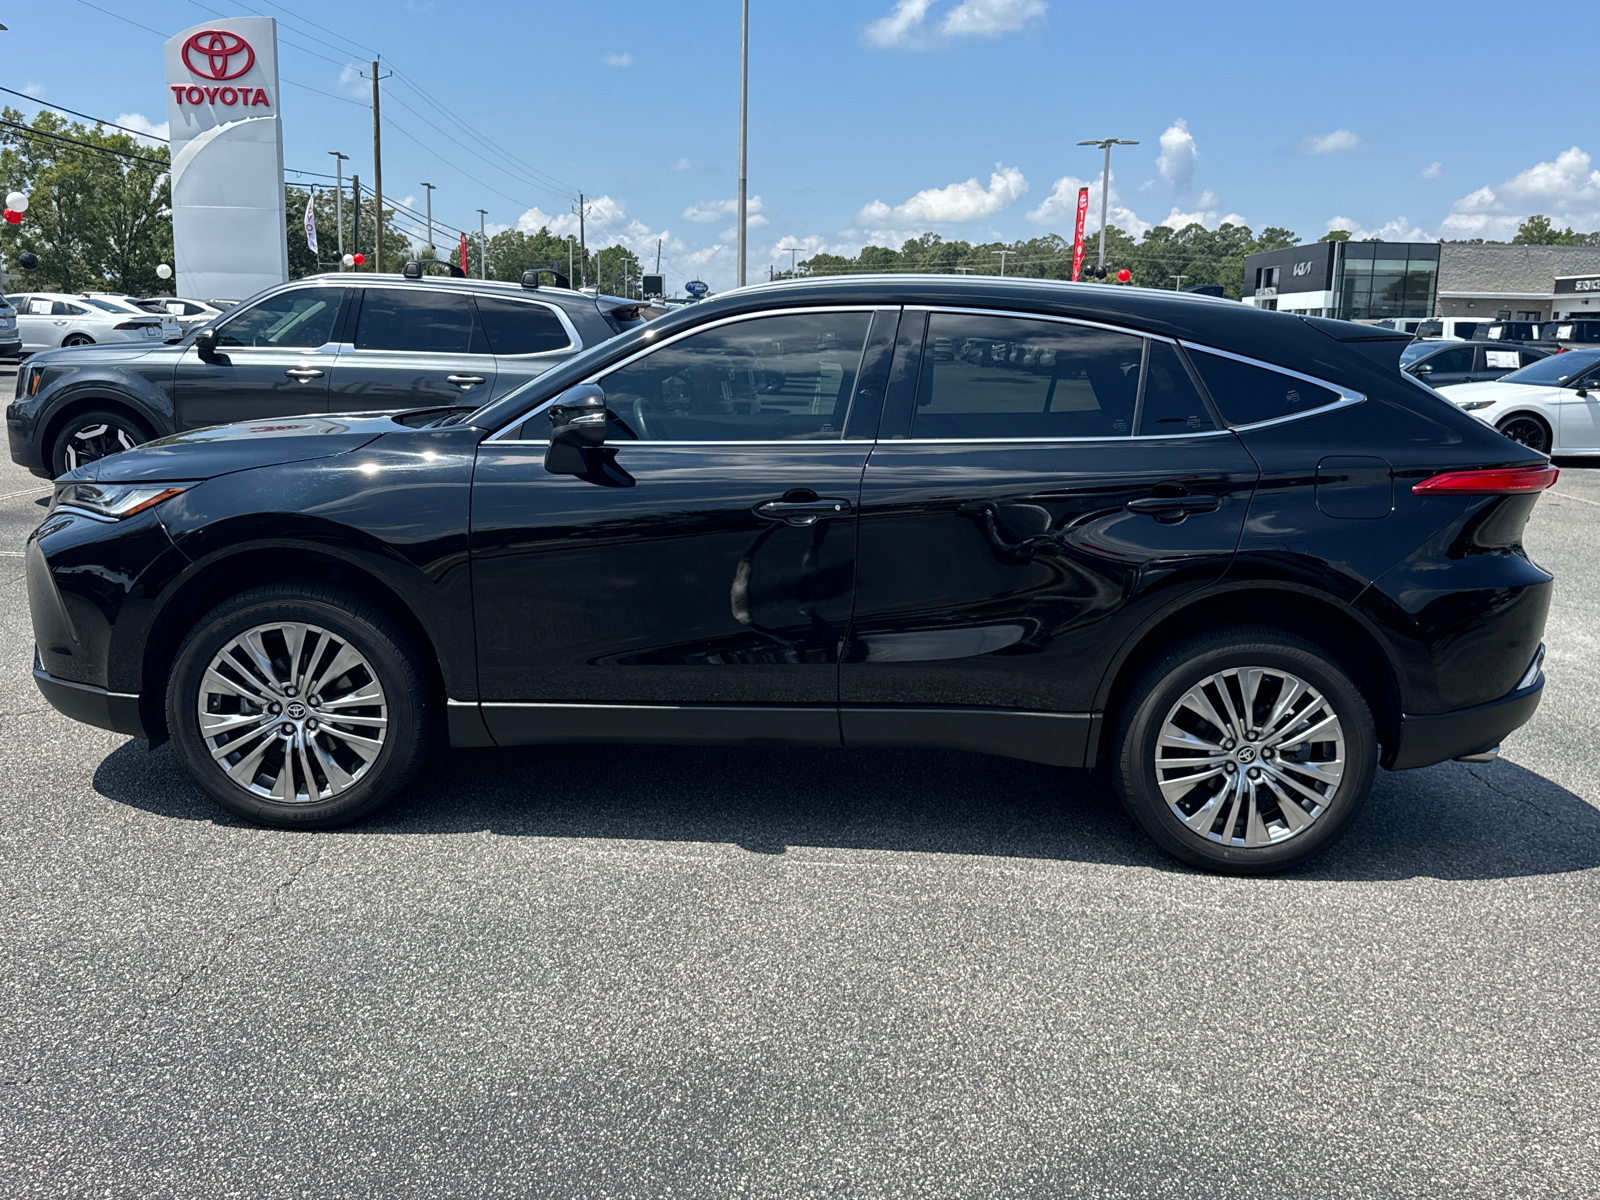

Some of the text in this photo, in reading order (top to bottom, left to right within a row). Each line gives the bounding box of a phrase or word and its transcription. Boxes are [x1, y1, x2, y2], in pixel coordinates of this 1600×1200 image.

[171, 86, 270, 107] TOYOTA
[1292, 261, 1313, 277] KIA
[1216, 643, 1314, 665] BRIDGESTONE
